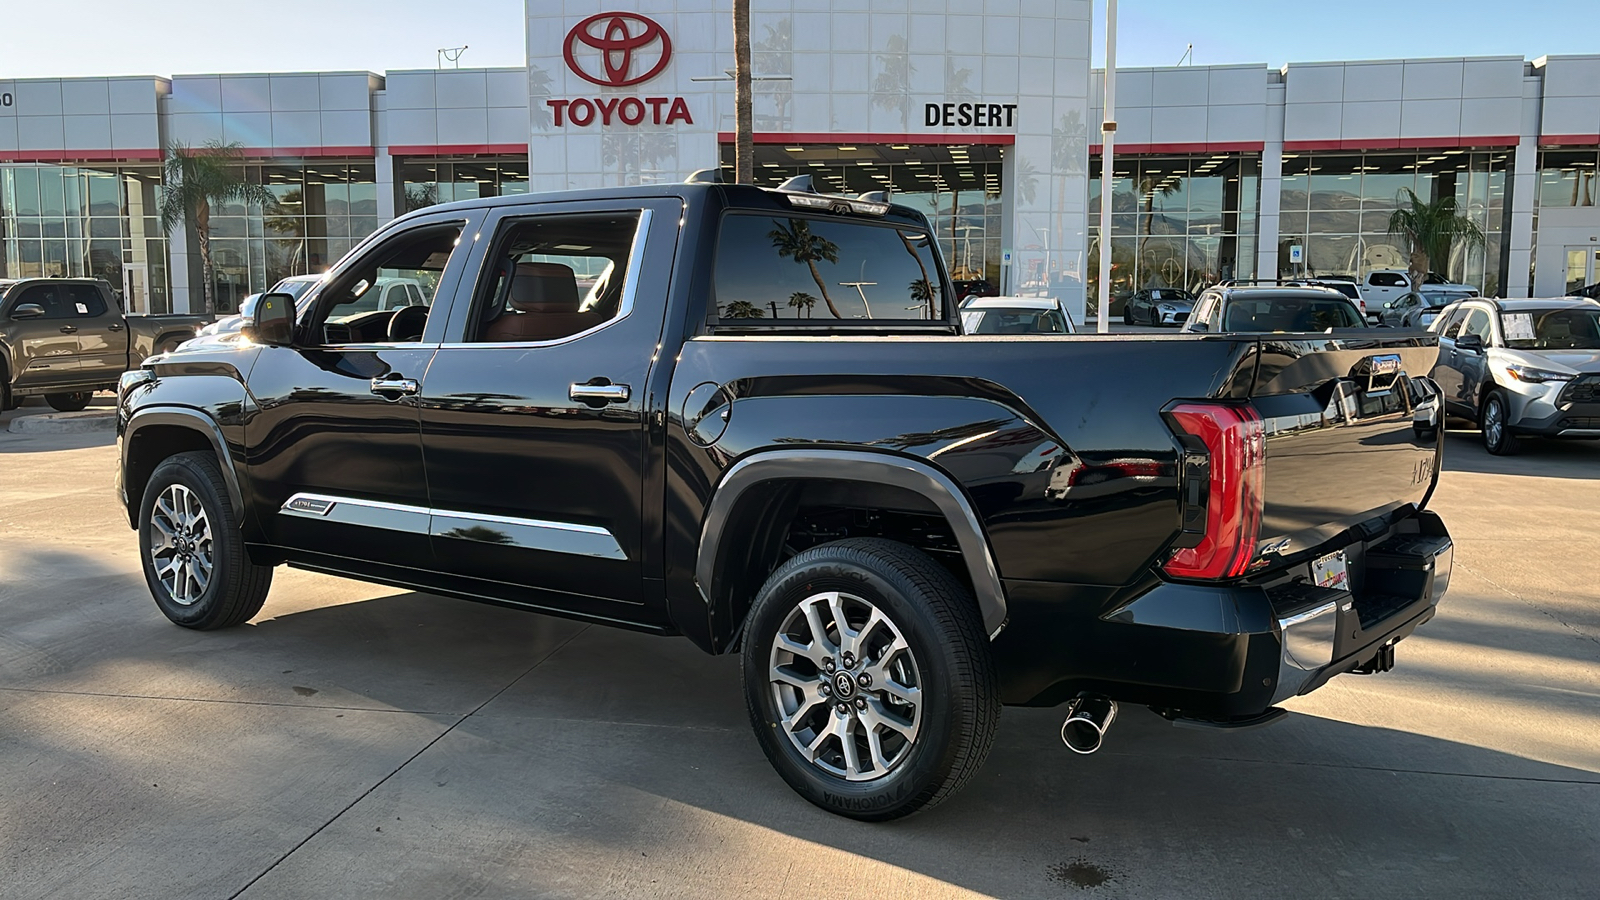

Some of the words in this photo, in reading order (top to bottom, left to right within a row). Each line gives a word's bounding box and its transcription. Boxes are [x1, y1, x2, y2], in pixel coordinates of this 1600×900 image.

[546, 97, 694, 127] TOYOTA
[925, 103, 1018, 127] DESERT
[822, 789, 896, 809] YOKOHAMA
